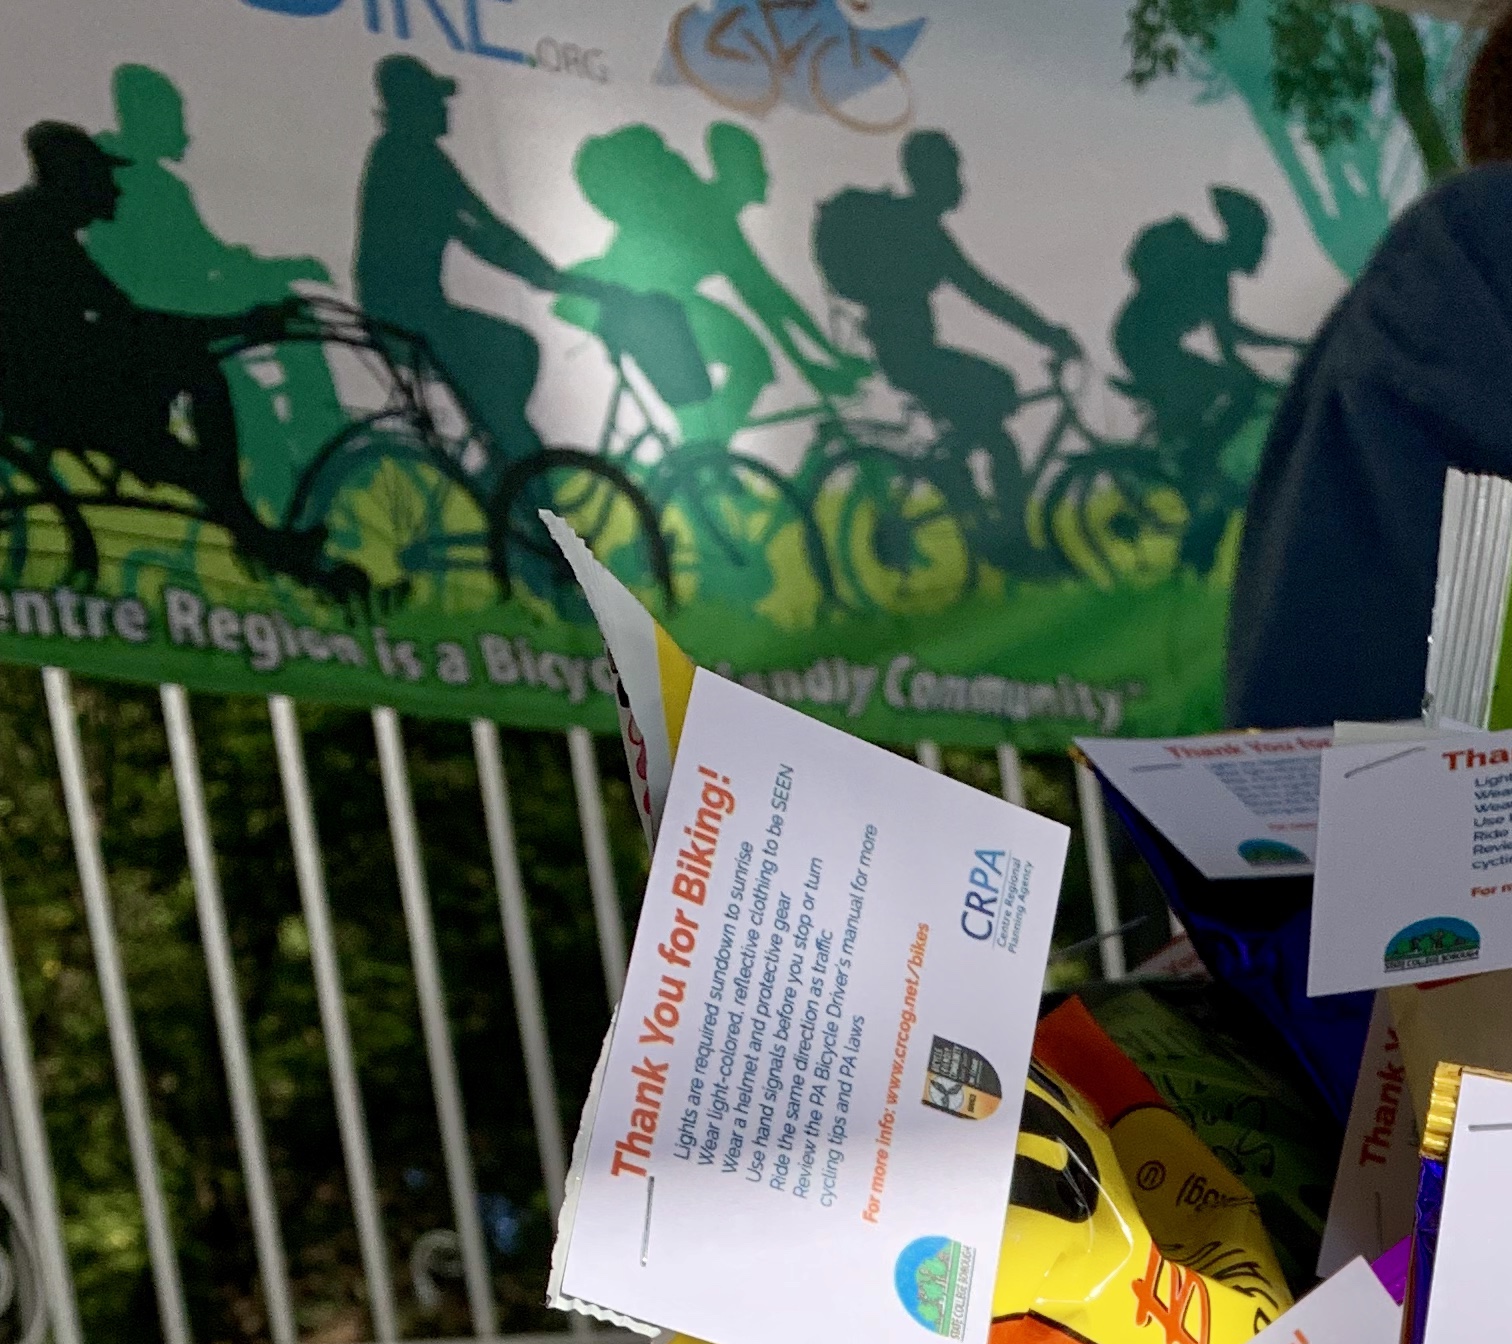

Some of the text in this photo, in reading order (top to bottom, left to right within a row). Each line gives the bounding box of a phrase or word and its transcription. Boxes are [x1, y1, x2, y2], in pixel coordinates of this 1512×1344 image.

[164, 587, 471, 684] Region is a
[609, 764, 735, 1181] Thank You for Biking!
[959, 849, 1006, 941] CRPA
[720, 889, 792, 1173] Wear a helmet and protective gear
[768, 927, 834, 1192] Ride the same direction as traffic
